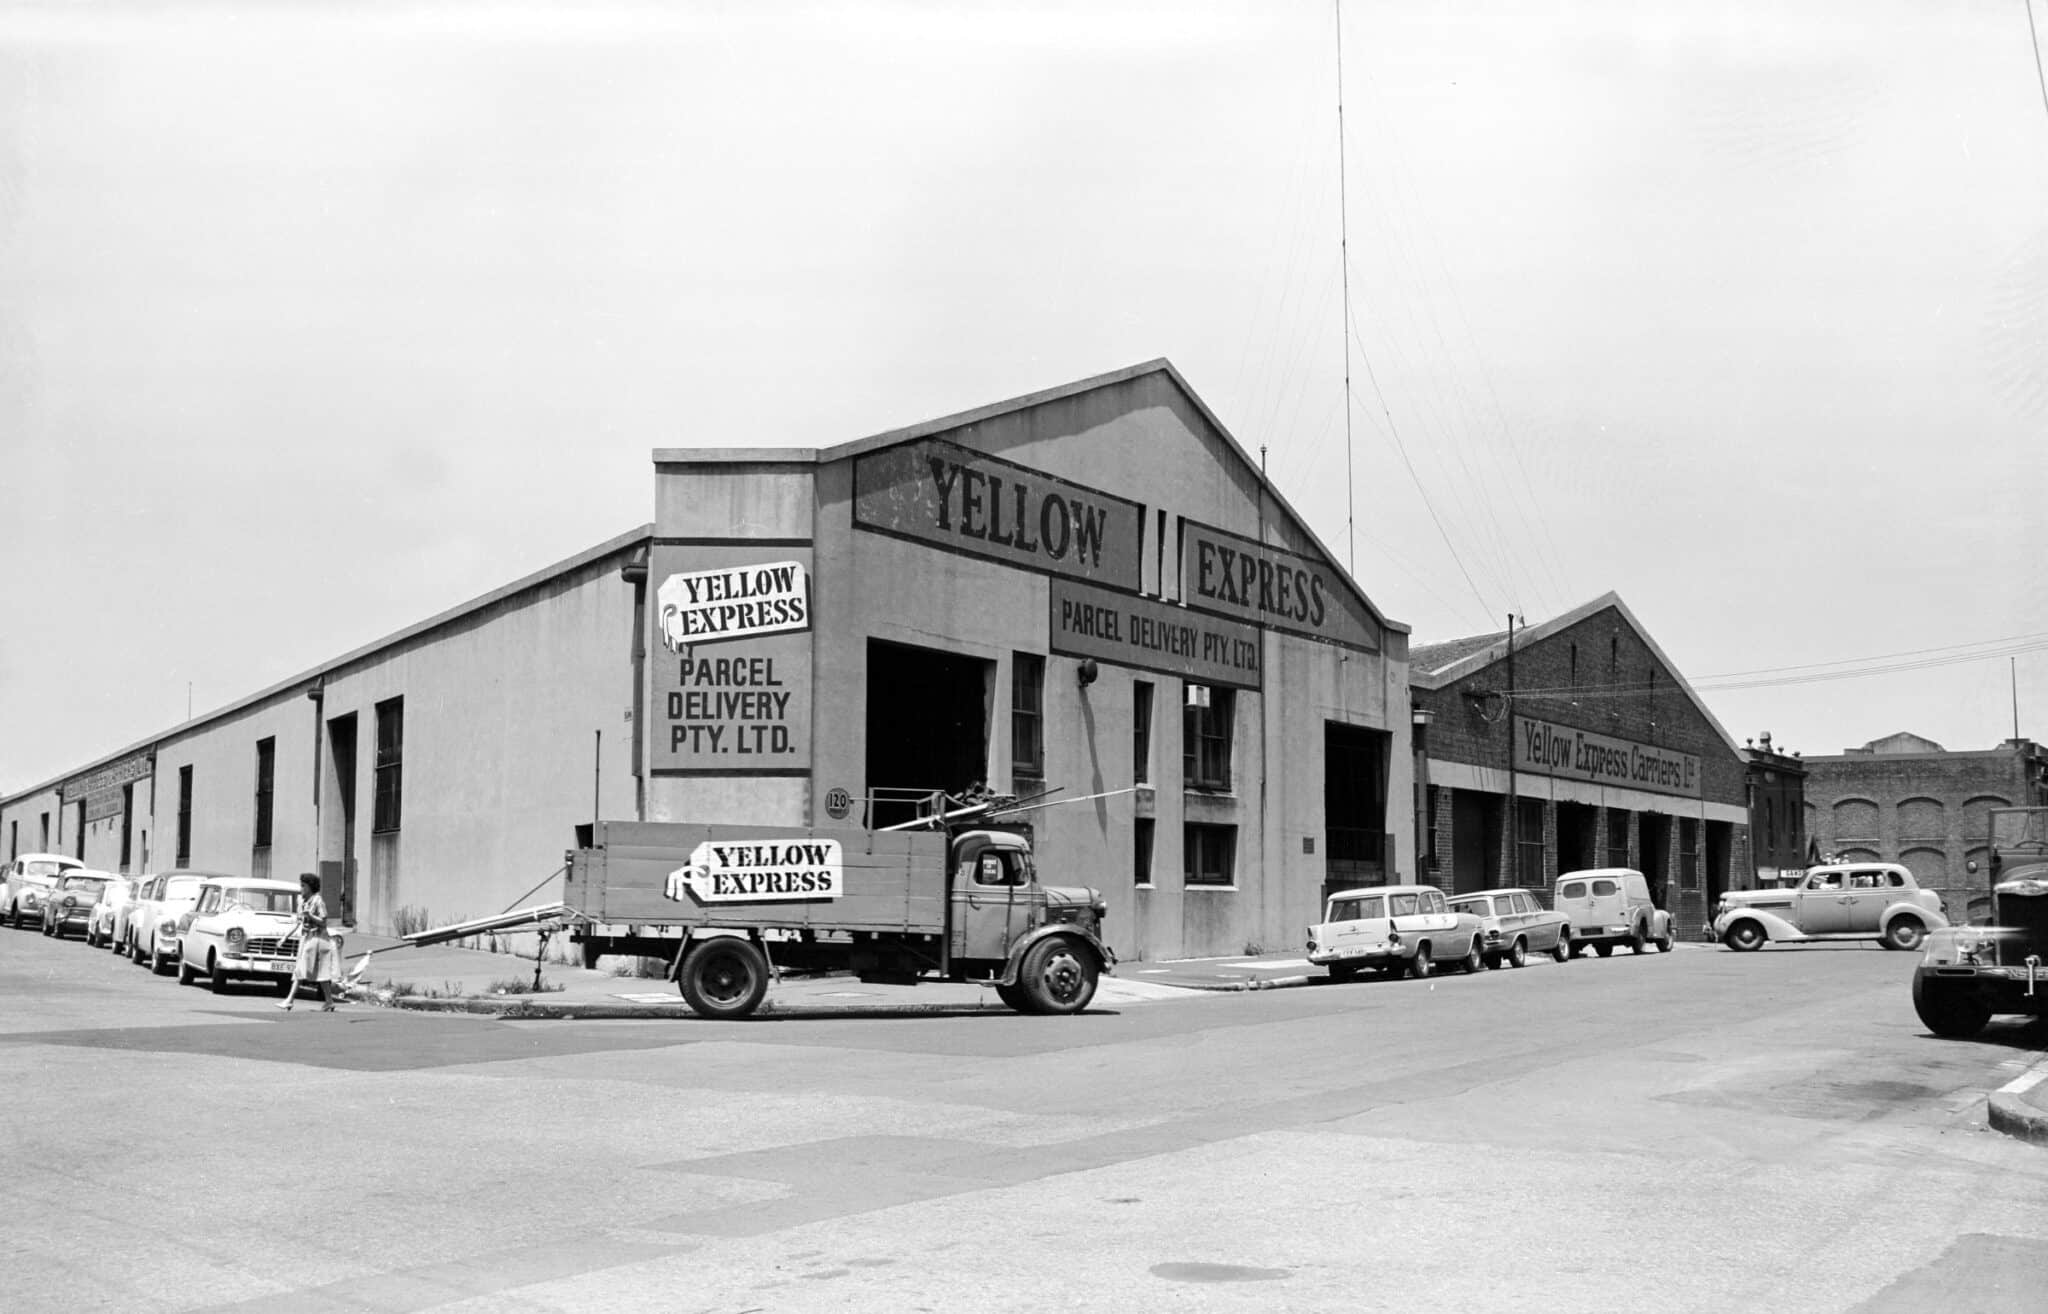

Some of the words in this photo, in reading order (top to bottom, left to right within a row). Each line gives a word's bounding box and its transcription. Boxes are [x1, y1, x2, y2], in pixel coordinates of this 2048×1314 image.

[927, 454, 1106, 568] YELLOW
[1198, 539, 1324, 627] EXPRESS
[683, 566, 796, 603] YELLOW
[681, 598, 804, 635] EXPRESS
[1063, 598, 1122, 642] PARCEL
[1130, 614, 1198, 658] DELIVERY
[1204, 631, 1229, 665] PTY.
[1234, 638, 1258, 672] LTD.
[680, 658, 782, 686] PARCEL
[668, 691, 791, 720] DELIVERY
[671, 725, 728, 753] PTY.
[737, 725, 795, 753] LTD.
[1524, 720, 1572, 768] Yellow
[1576, 732, 1628, 778] Express
[1632, 745, 1681, 788] Carriers
[830, 793, 847, 807] 120
[713, 845, 832, 867] YELLOW
[713, 871, 832, 894] EXPRESS
